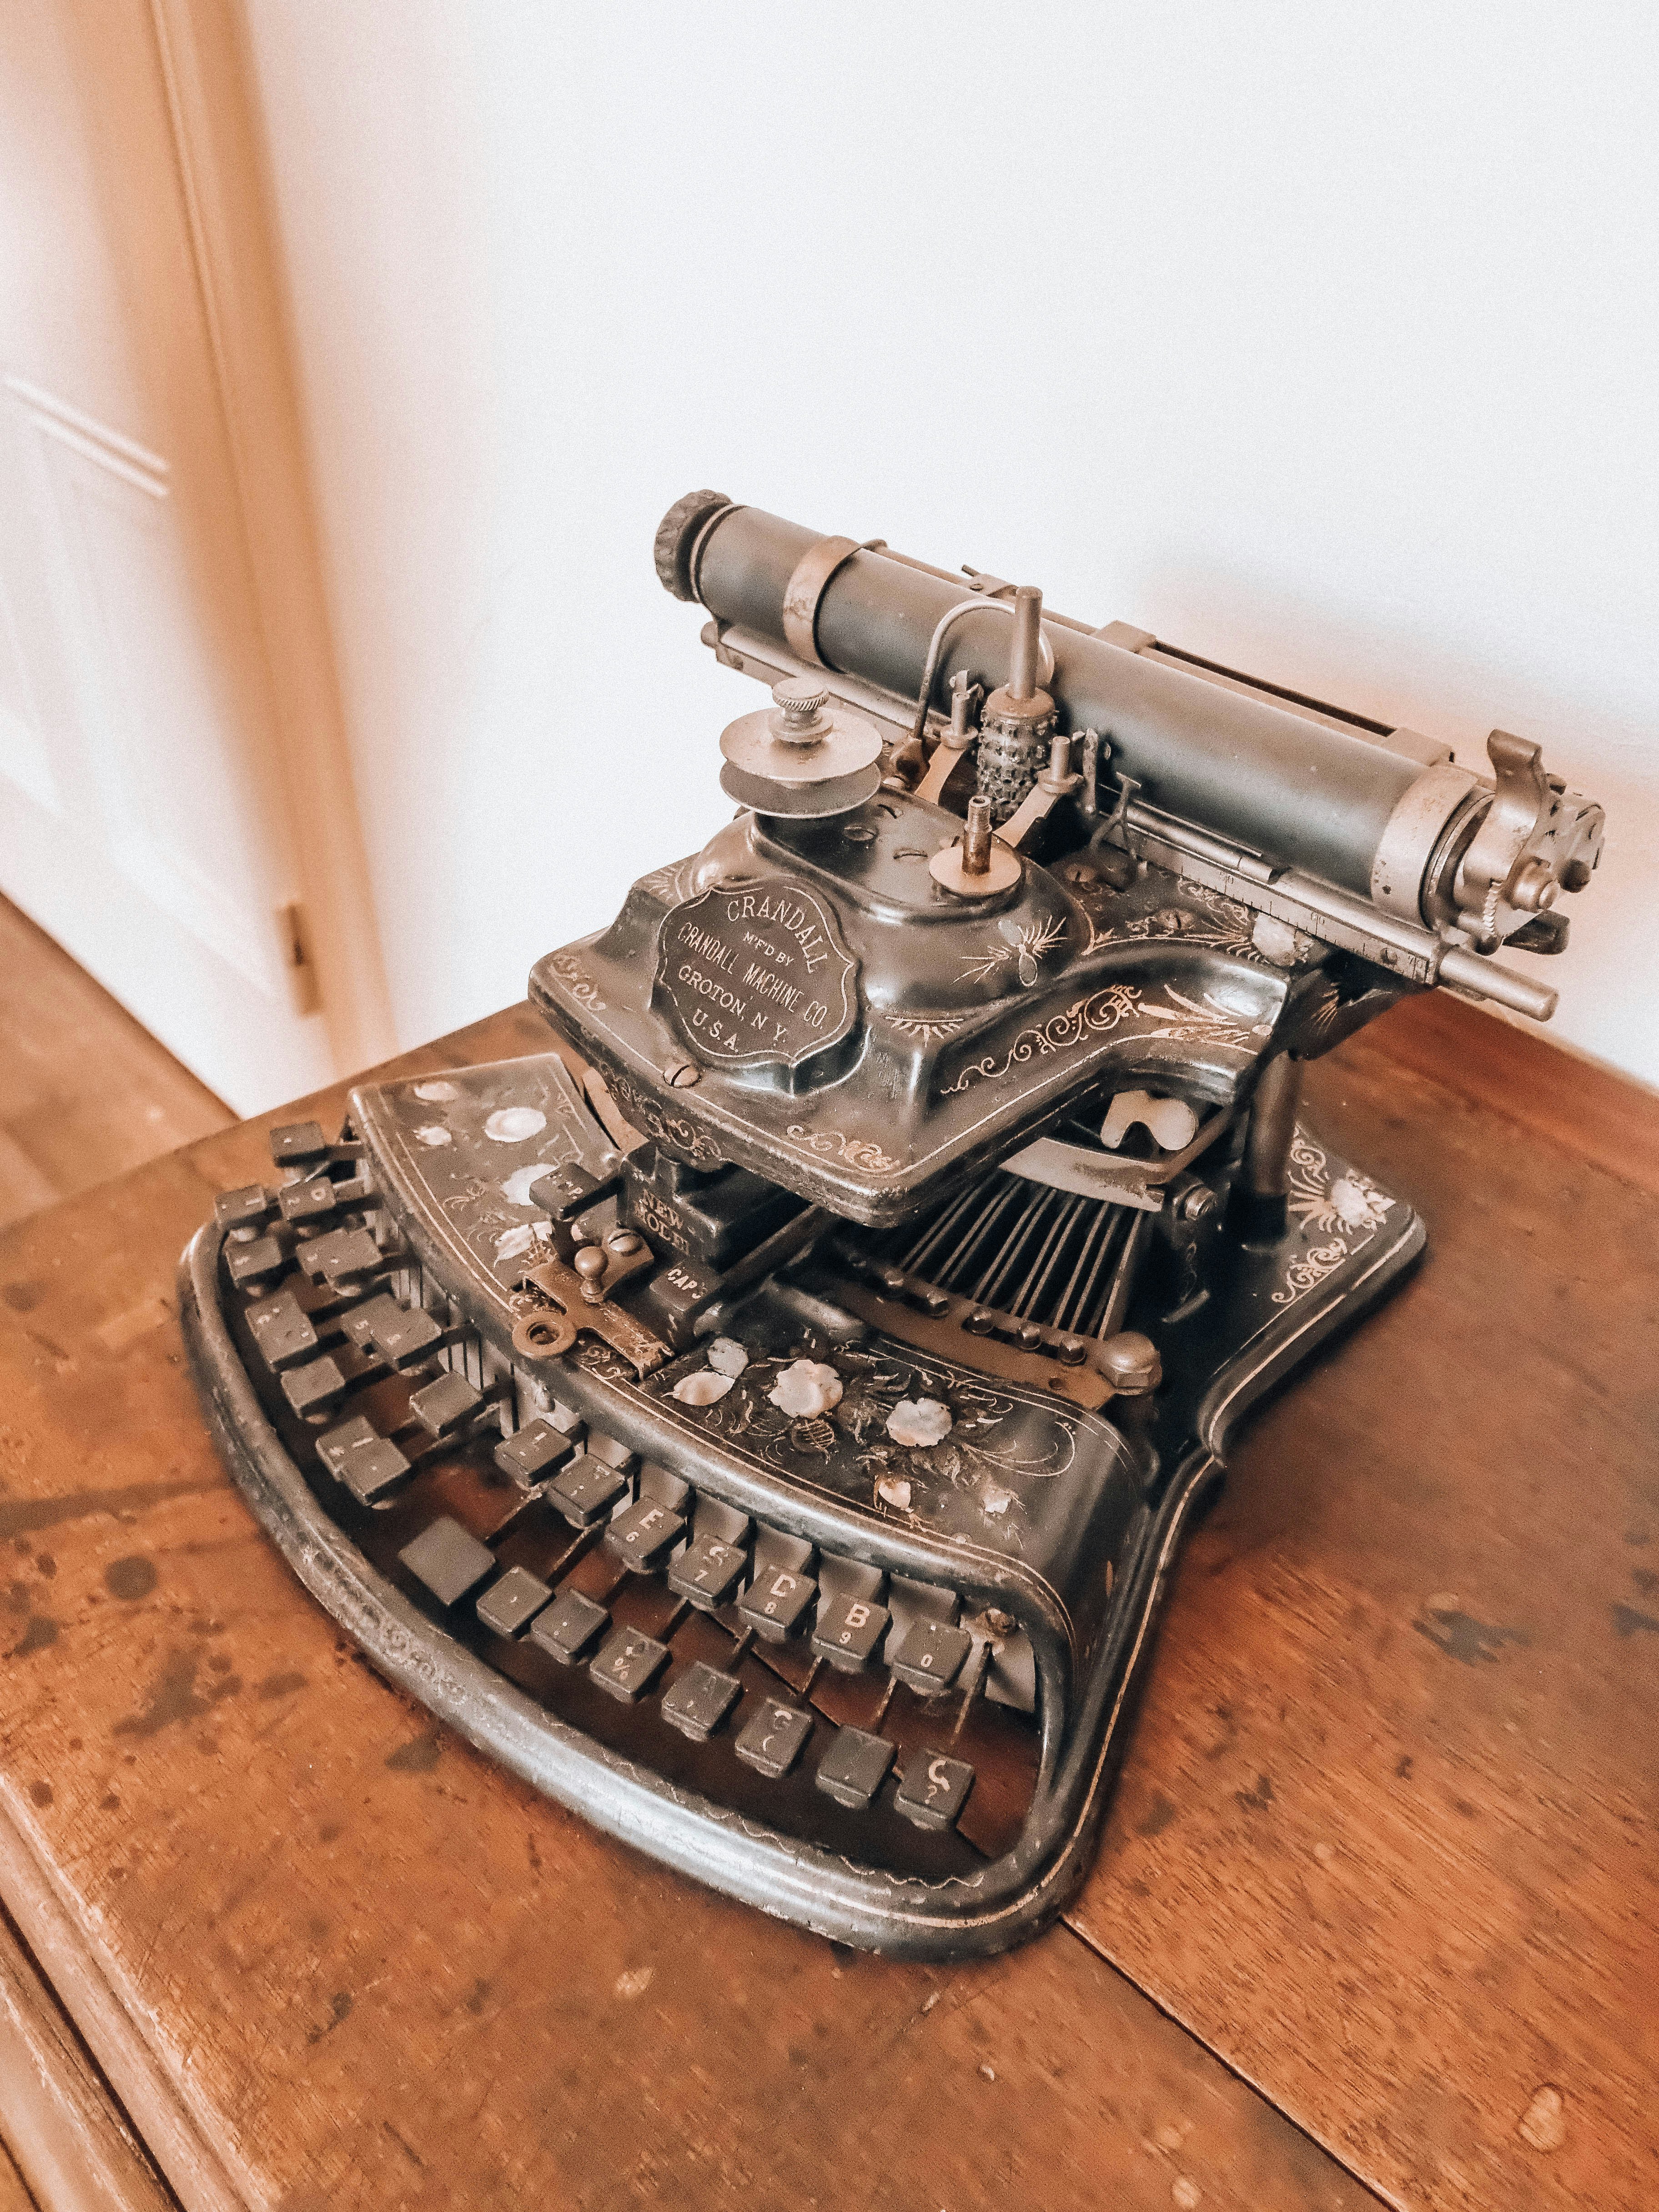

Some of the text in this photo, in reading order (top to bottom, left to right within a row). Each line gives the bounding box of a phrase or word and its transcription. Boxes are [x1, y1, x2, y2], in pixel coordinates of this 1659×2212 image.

[727, 895, 828, 974] CRANDALL
[775, 952, 794, 966] BY
[678, 922, 827, 1030] CRANDALL MACHINE CO.
[679, 965, 747, 1021] GROTON,
[639, 1187, 684, 1229] NEW
[639, 1508, 664, 1529] E
[764, 1601, 777, 1614] 8
[845, 1603, 870, 1628] B
[839, 1631, 852, 1644] 9
[924, 1784, 938, 1805] ?
